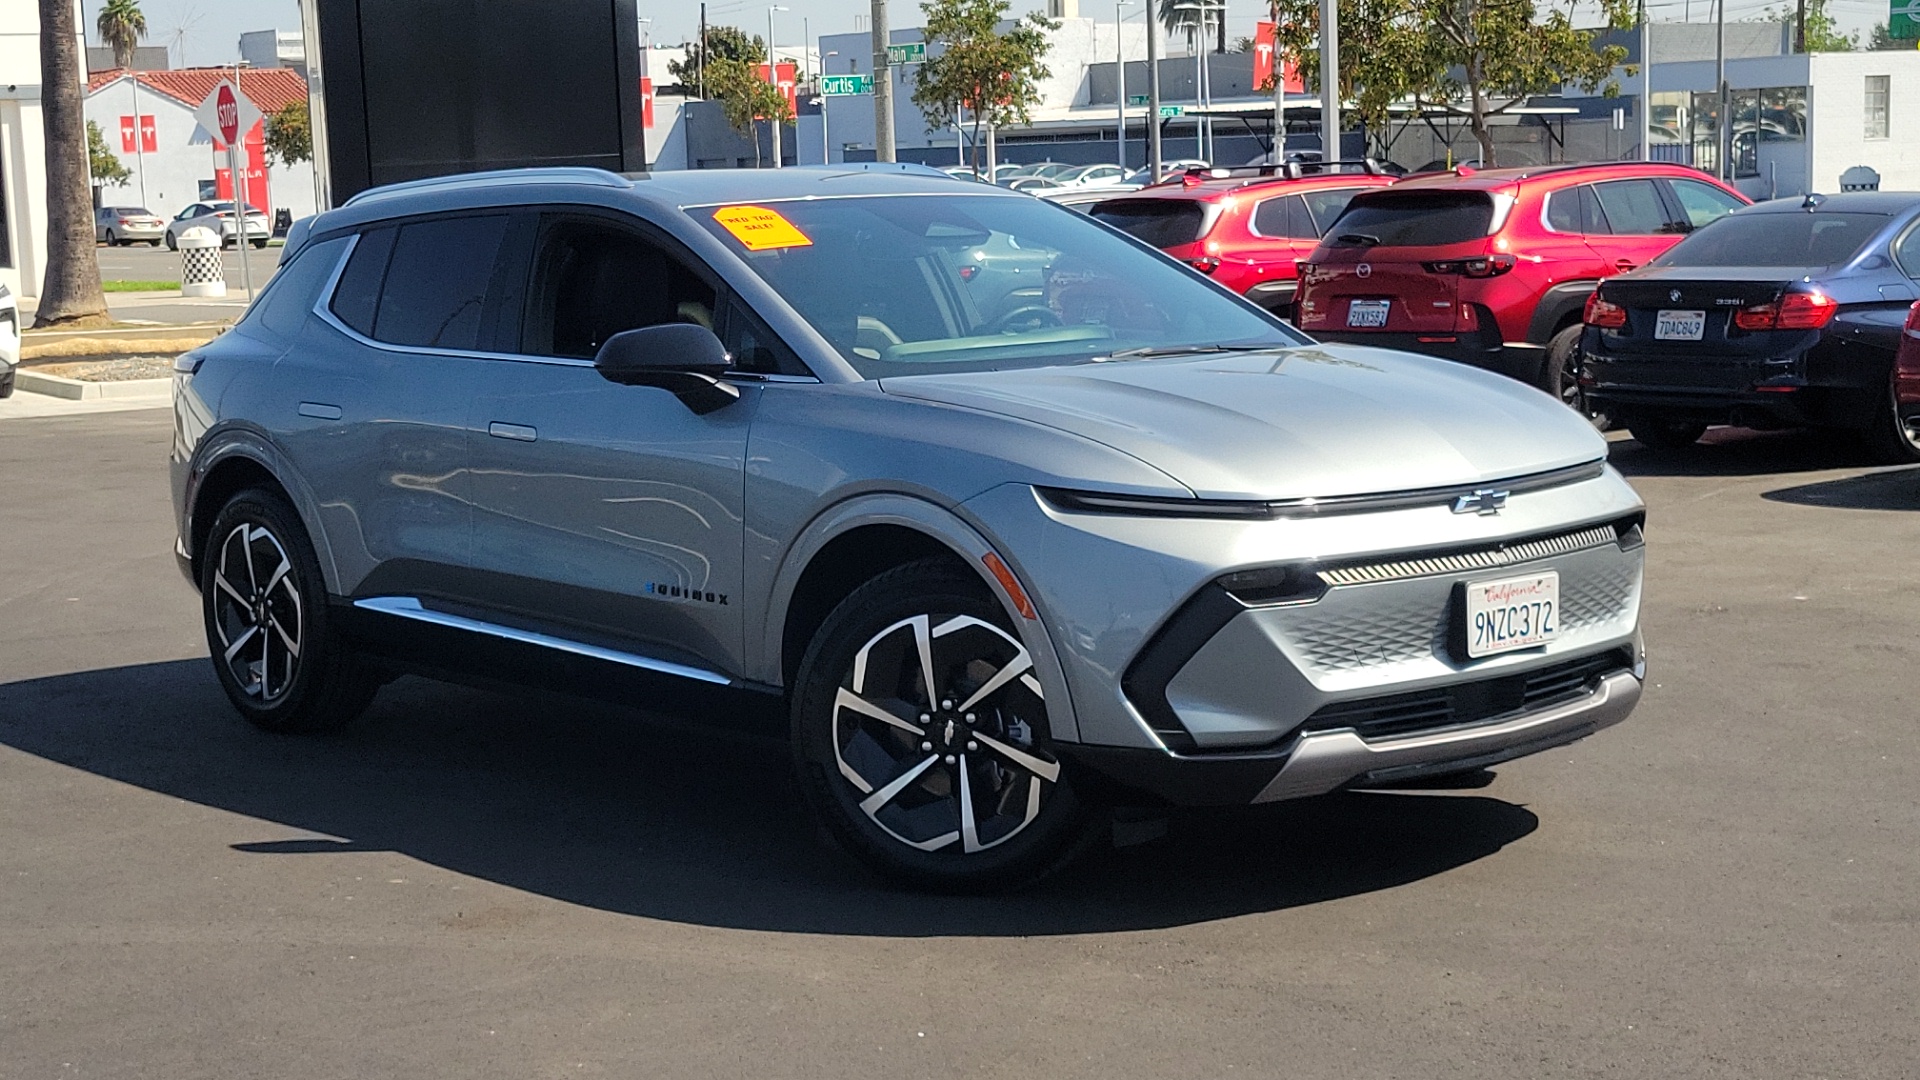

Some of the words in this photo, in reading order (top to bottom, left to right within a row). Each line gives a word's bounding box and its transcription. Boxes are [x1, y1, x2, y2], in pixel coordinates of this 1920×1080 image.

[887, 46, 906, 62] Main
[822, 78, 854, 93] Curtis
[219, 103, 236, 128] STOP
[223, 170, 262, 178] TSLA
[1660, 321, 1700, 336] 7DAC849
[645, 581, 728, 606] EQUINOX
[1486, 581, 1542, 604] California
[1475, 600, 1554, 647] 9NZC372
